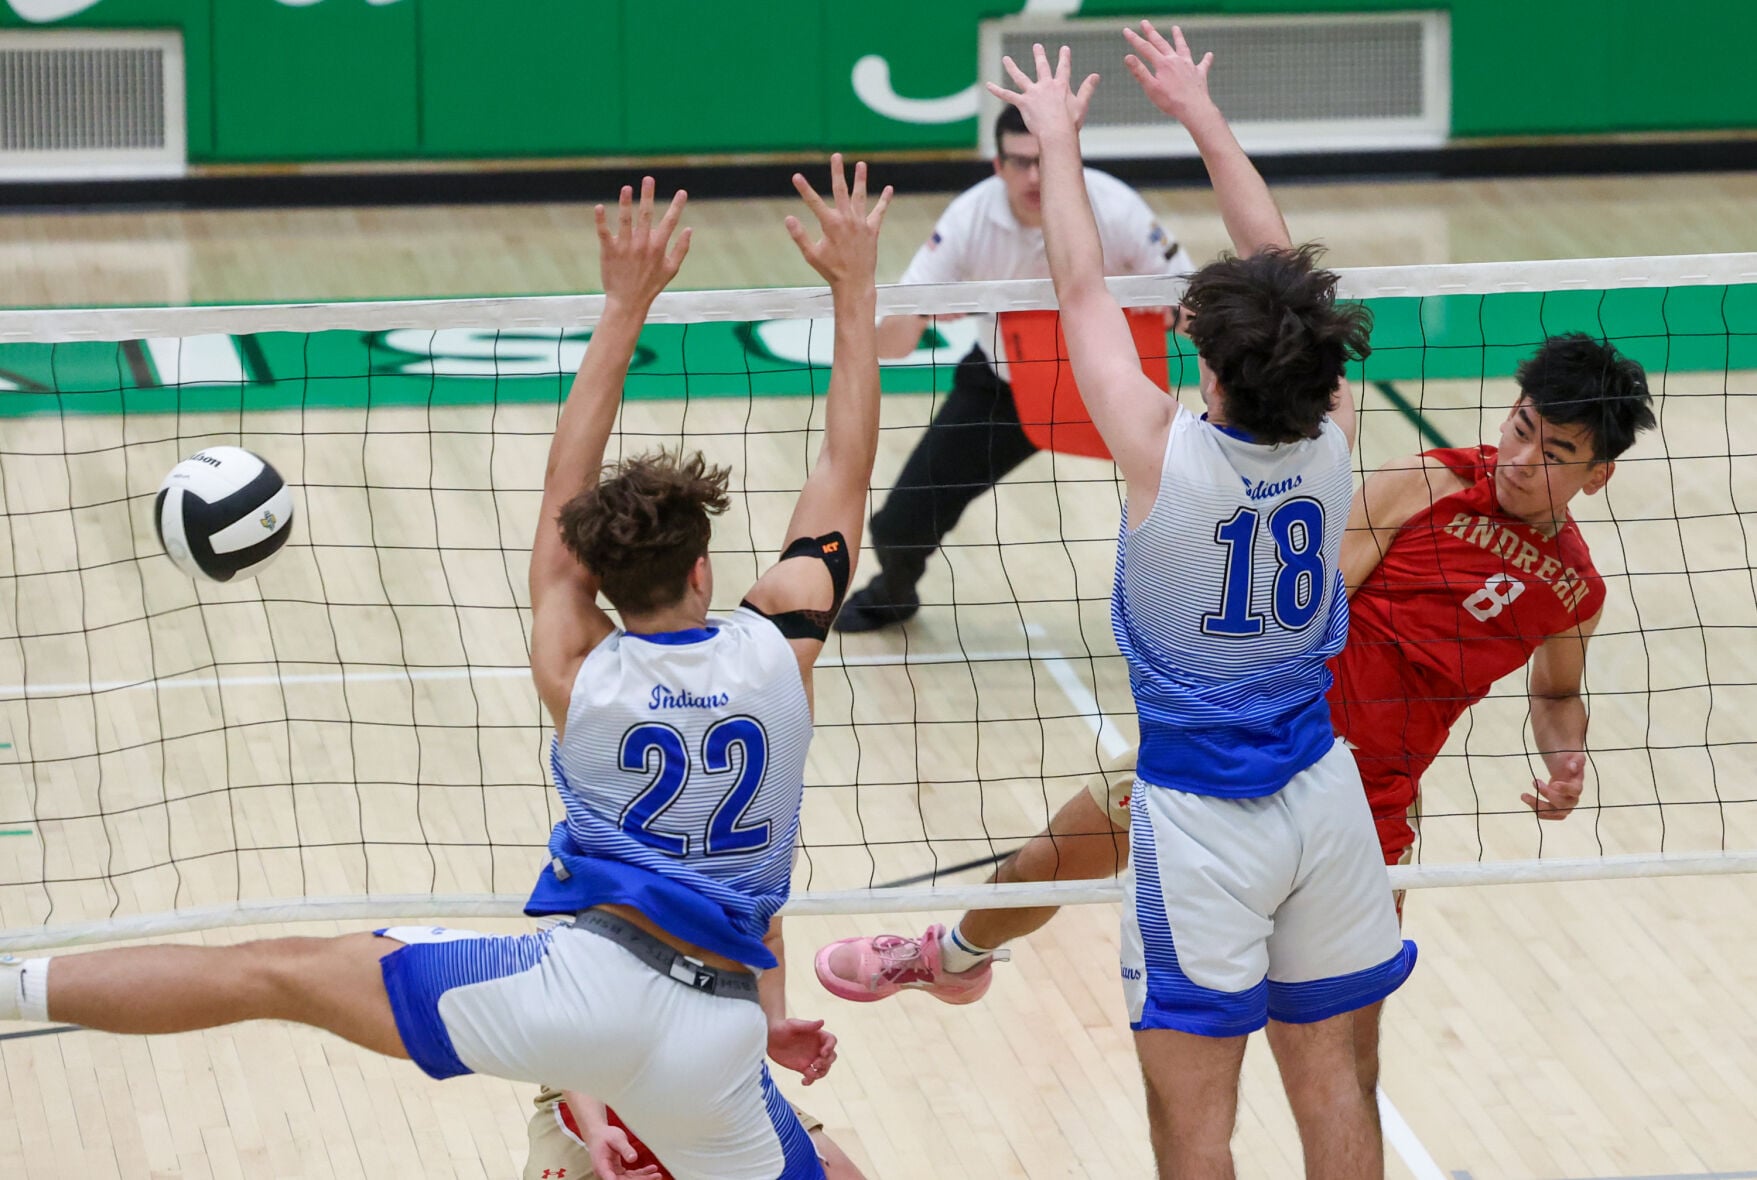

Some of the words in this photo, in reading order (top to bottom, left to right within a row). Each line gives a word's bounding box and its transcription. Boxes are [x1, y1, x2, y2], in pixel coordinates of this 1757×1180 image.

[822, 541, 839, 554] KT
[1202, 495, 1326, 637] 18
[1443, 512, 1590, 614] ANDREAN
[1462, 573, 1526, 622] 8
[649, 684, 730, 710] Indians
[617, 714, 772, 857] 22
